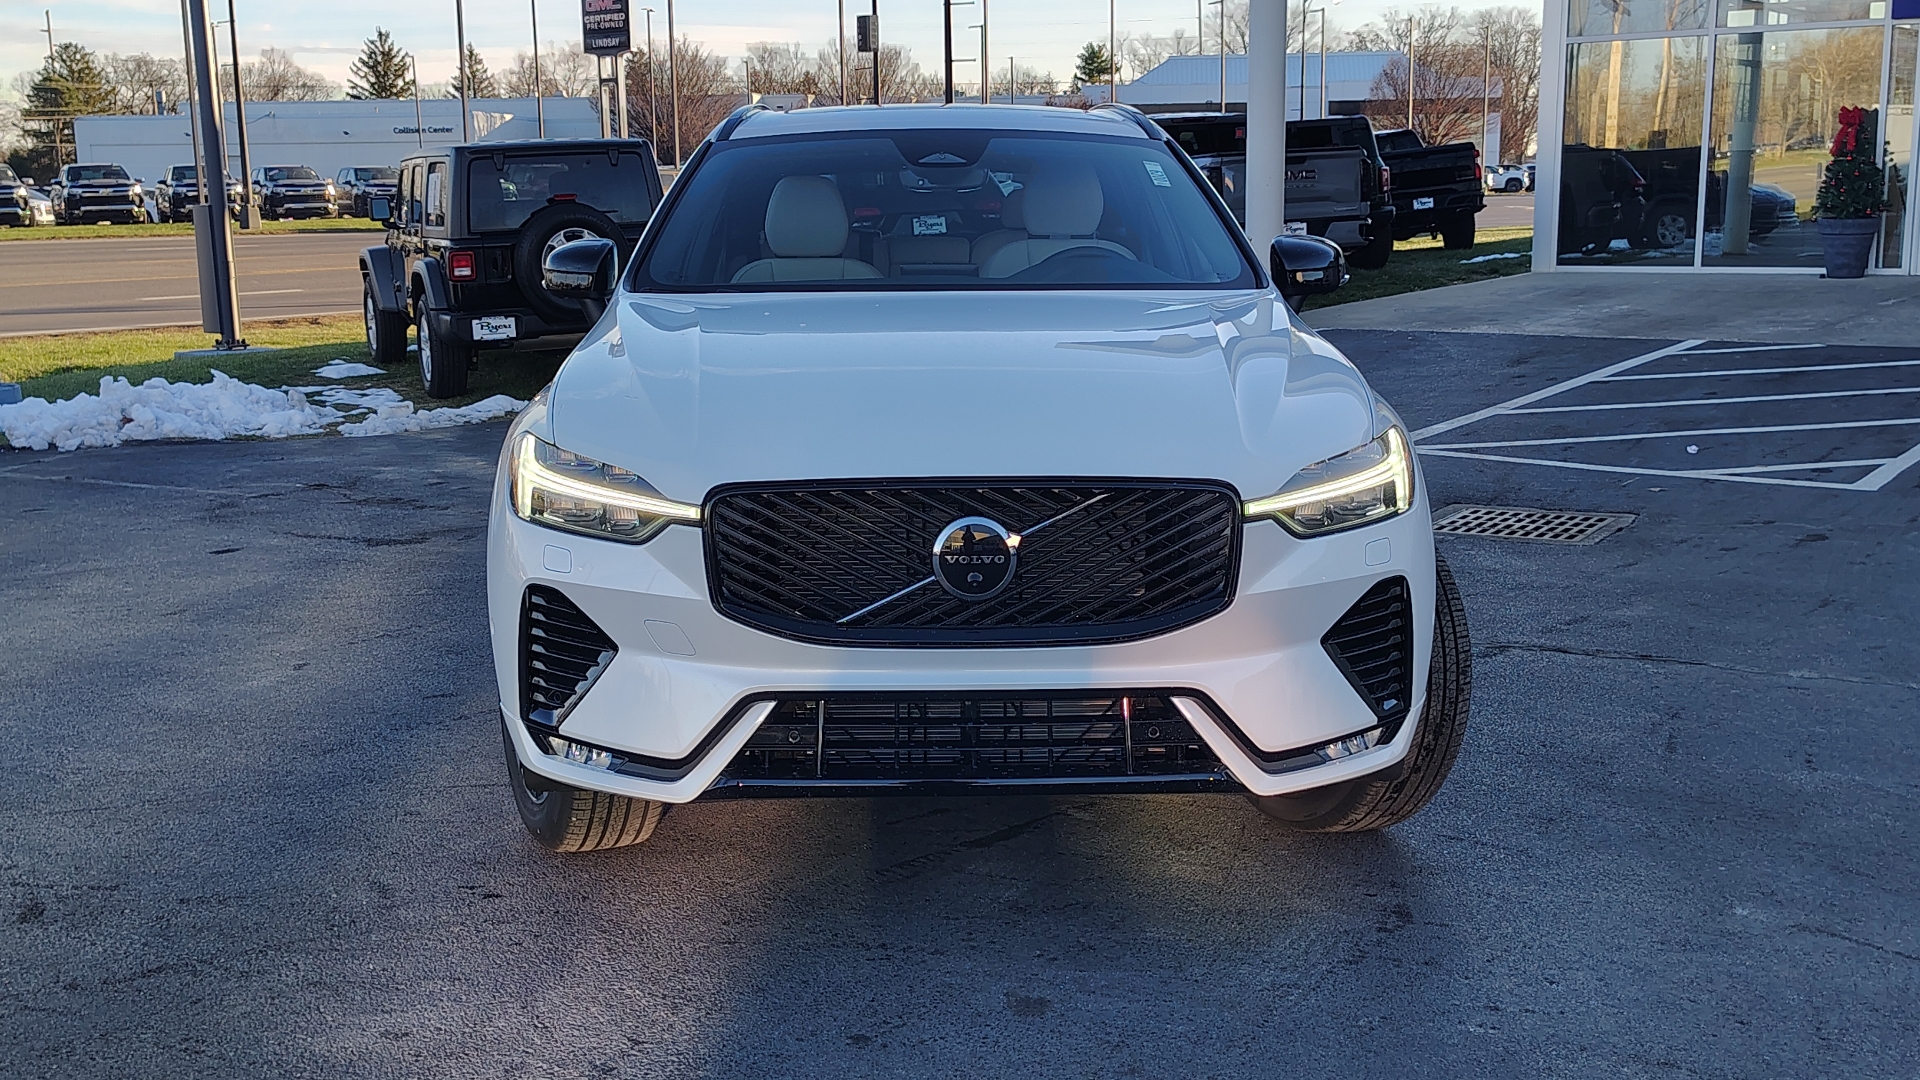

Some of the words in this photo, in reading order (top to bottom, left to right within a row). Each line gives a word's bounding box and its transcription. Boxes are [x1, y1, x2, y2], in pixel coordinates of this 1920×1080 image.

[584, 12, 626, 23] CERTIFIED
[586, 20, 624, 30] PRE-OWNED
[592, 37, 620, 48] LINDSAY
[427, 126, 454, 134] Center
[1284, 169, 1318, 181] MC
[944, 555, 1005, 564] VOLVO
